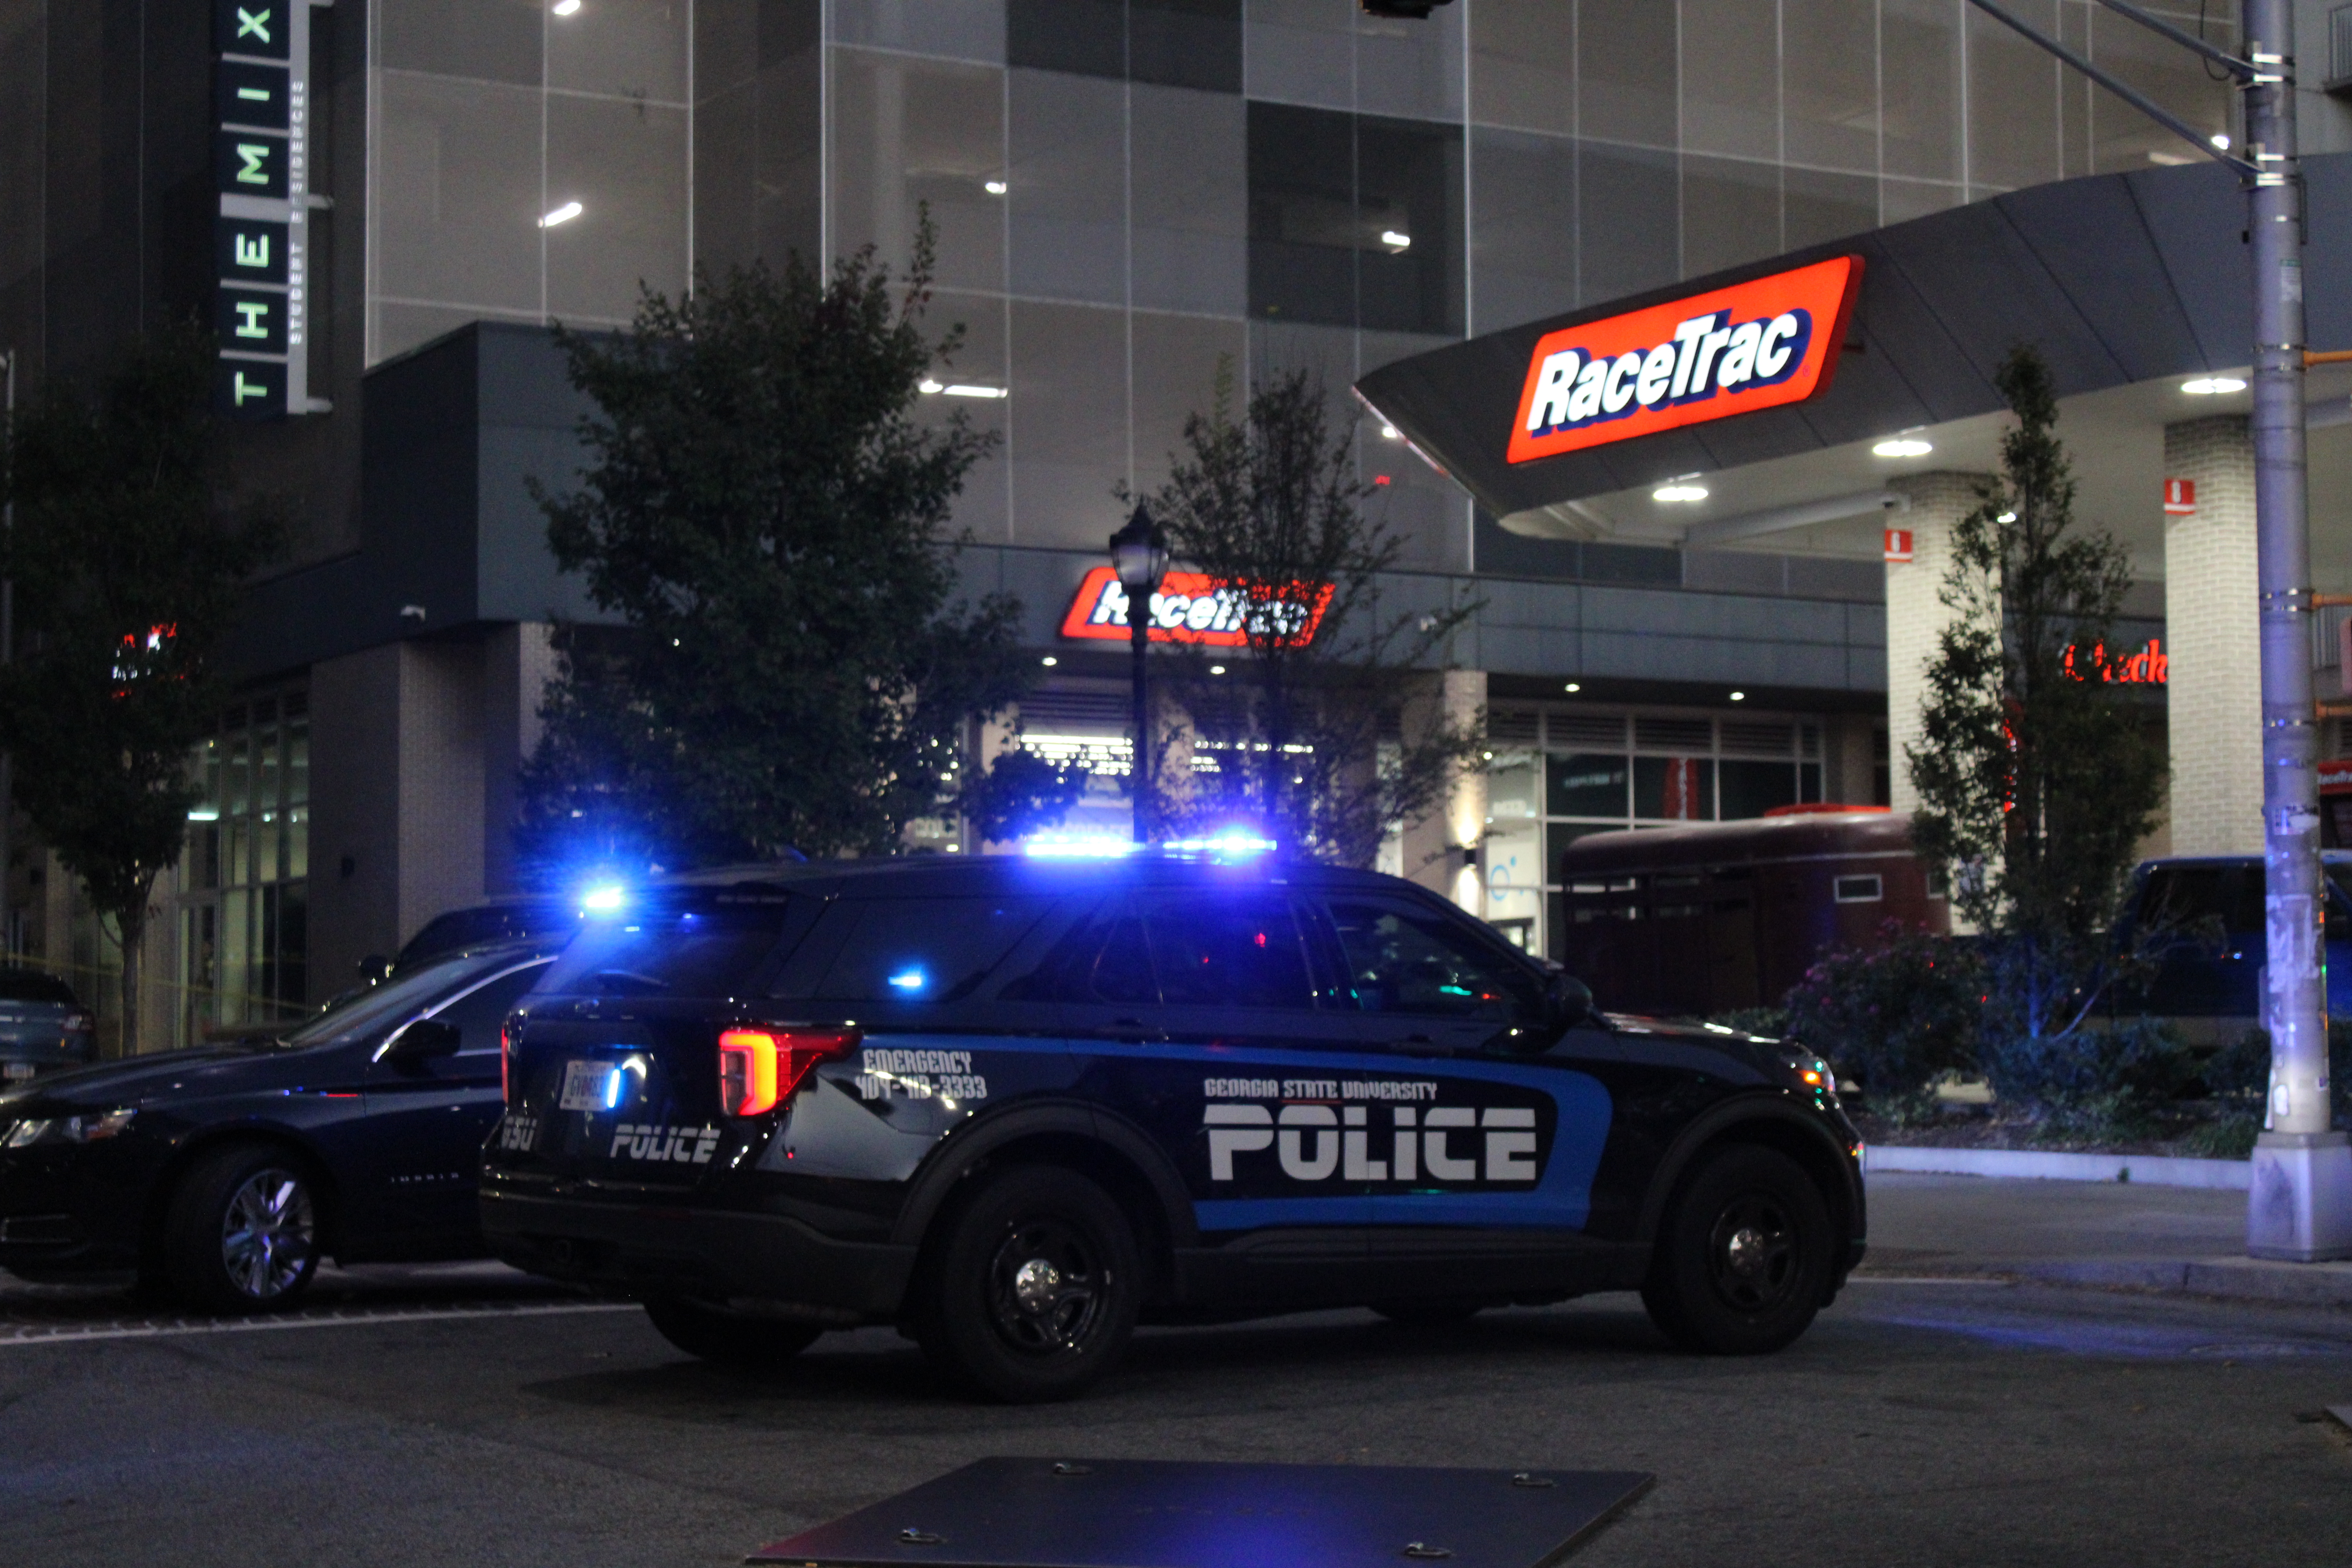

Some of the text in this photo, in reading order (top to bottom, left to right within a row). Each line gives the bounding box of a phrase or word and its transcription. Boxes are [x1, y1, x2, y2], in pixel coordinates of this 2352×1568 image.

[235, 5, 270, 407] THE MIX
[290, 80, 304, 345] STUDENT RESIDENCES
[1526, 312, 1798, 431] RaceTrac
[863, 1049, 972, 1074] EMERGENCY
[1205, 1078, 1437, 1100] GEORGIA STATE UNIVERSITY
[610, 1124, 721, 1163] POLICE
[1203, 1104, 1536, 1180] POLICE
